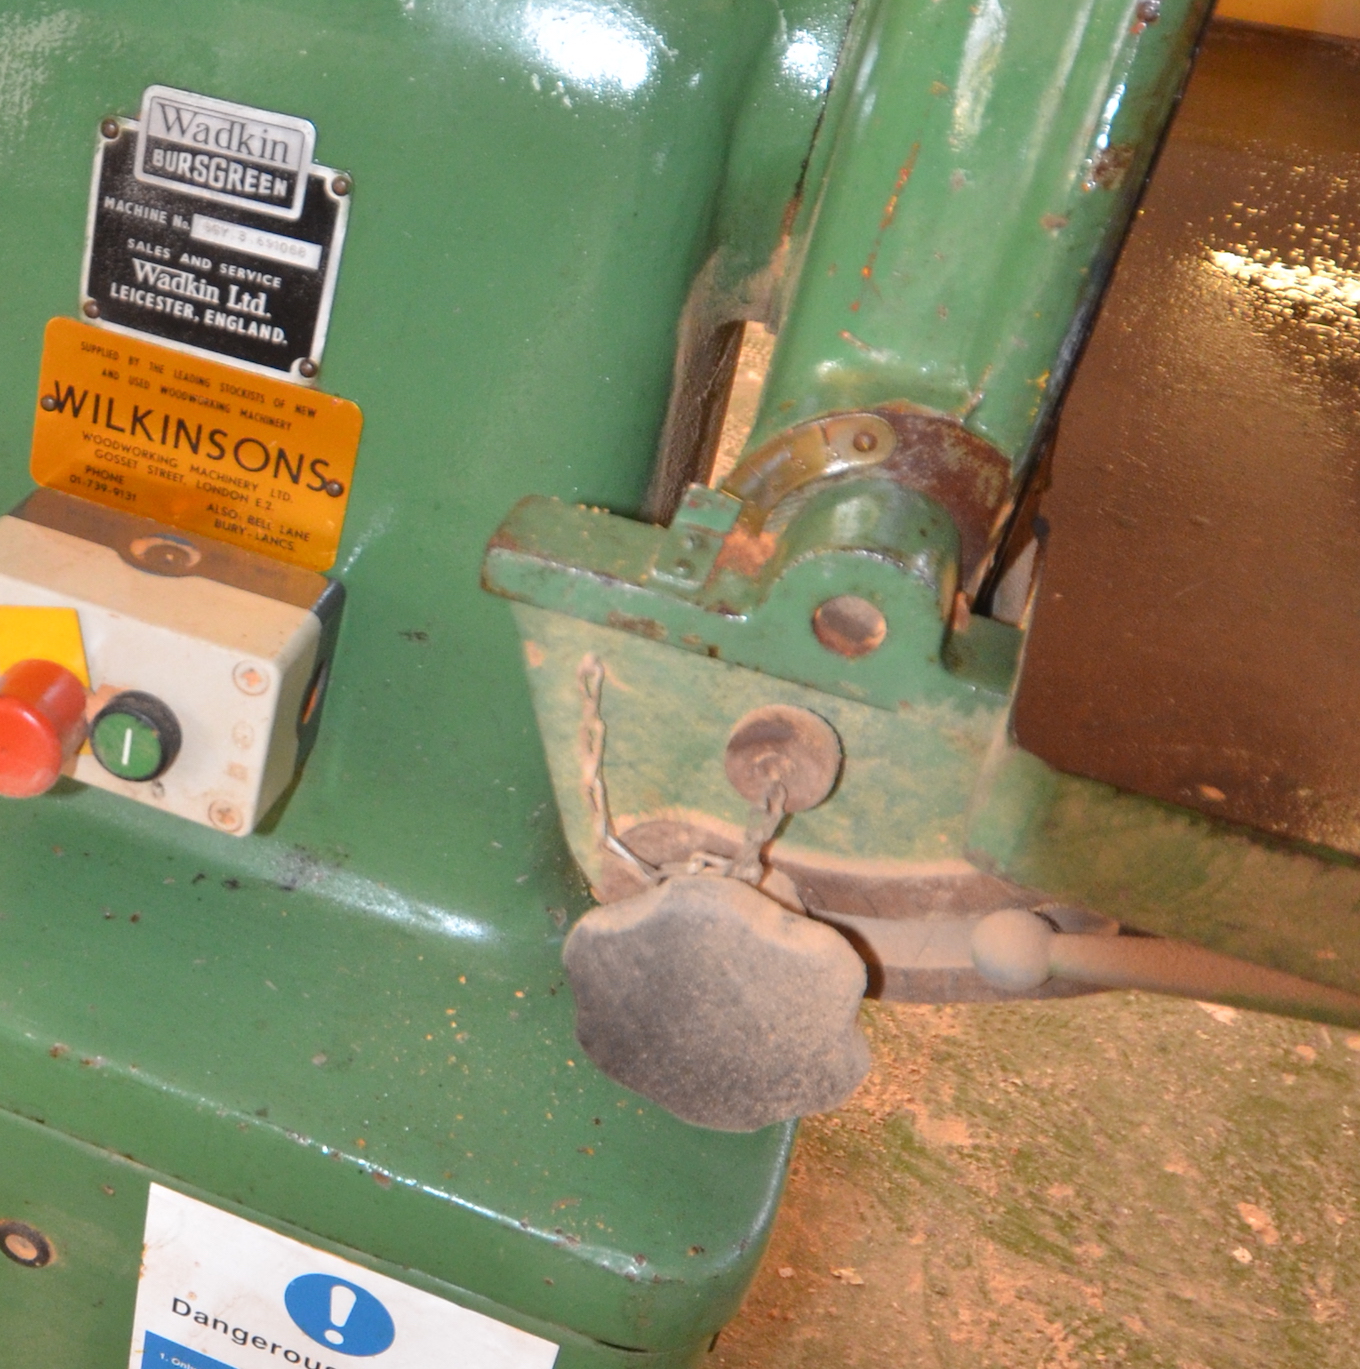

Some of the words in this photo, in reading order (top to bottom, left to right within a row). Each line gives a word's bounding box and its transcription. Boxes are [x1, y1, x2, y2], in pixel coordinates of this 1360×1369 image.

[156, 102, 289, 164] Wadkin
[151, 149, 289, 197] BURSGREEN
[104, 196, 168, 224] MACHINE
[127, 238, 171, 259] SALES
[179, 253, 213, 270] AND
[219, 263, 282, 288] SERVICE
[130, 258, 221, 304] Wadkin
[226, 284, 274, 318] Ltd.
[110, 282, 201, 322] LEICESTER,
[204, 309, 290, 344] ENGLAND.
[80, 341, 120, 361] SUPPLIED
[149, 362, 164, 374] THE
[174, 371, 210, 388] LEADING
[220, 383, 266, 404] STOCKISTS
[294, 405, 317, 417] NEW
[102, 370, 119, 381] AND
[128, 377, 150, 389] USED
[160, 387, 230, 413] WOODWORKING
[239, 409, 292, 430] MACHINERY
[52, 380, 330, 493] WILKINSONS
[82, 430, 179, 469] WOODWORKING
[189, 464, 258, 491] MACHINERY
[84, 465, 124, 485] PHONE
[94, 449, 138, 469] GOSSET
[195, 480, 249, 503] LONDON
[246, 515, 272, 531] BELL
[278, 525, 310, 542] LANE
